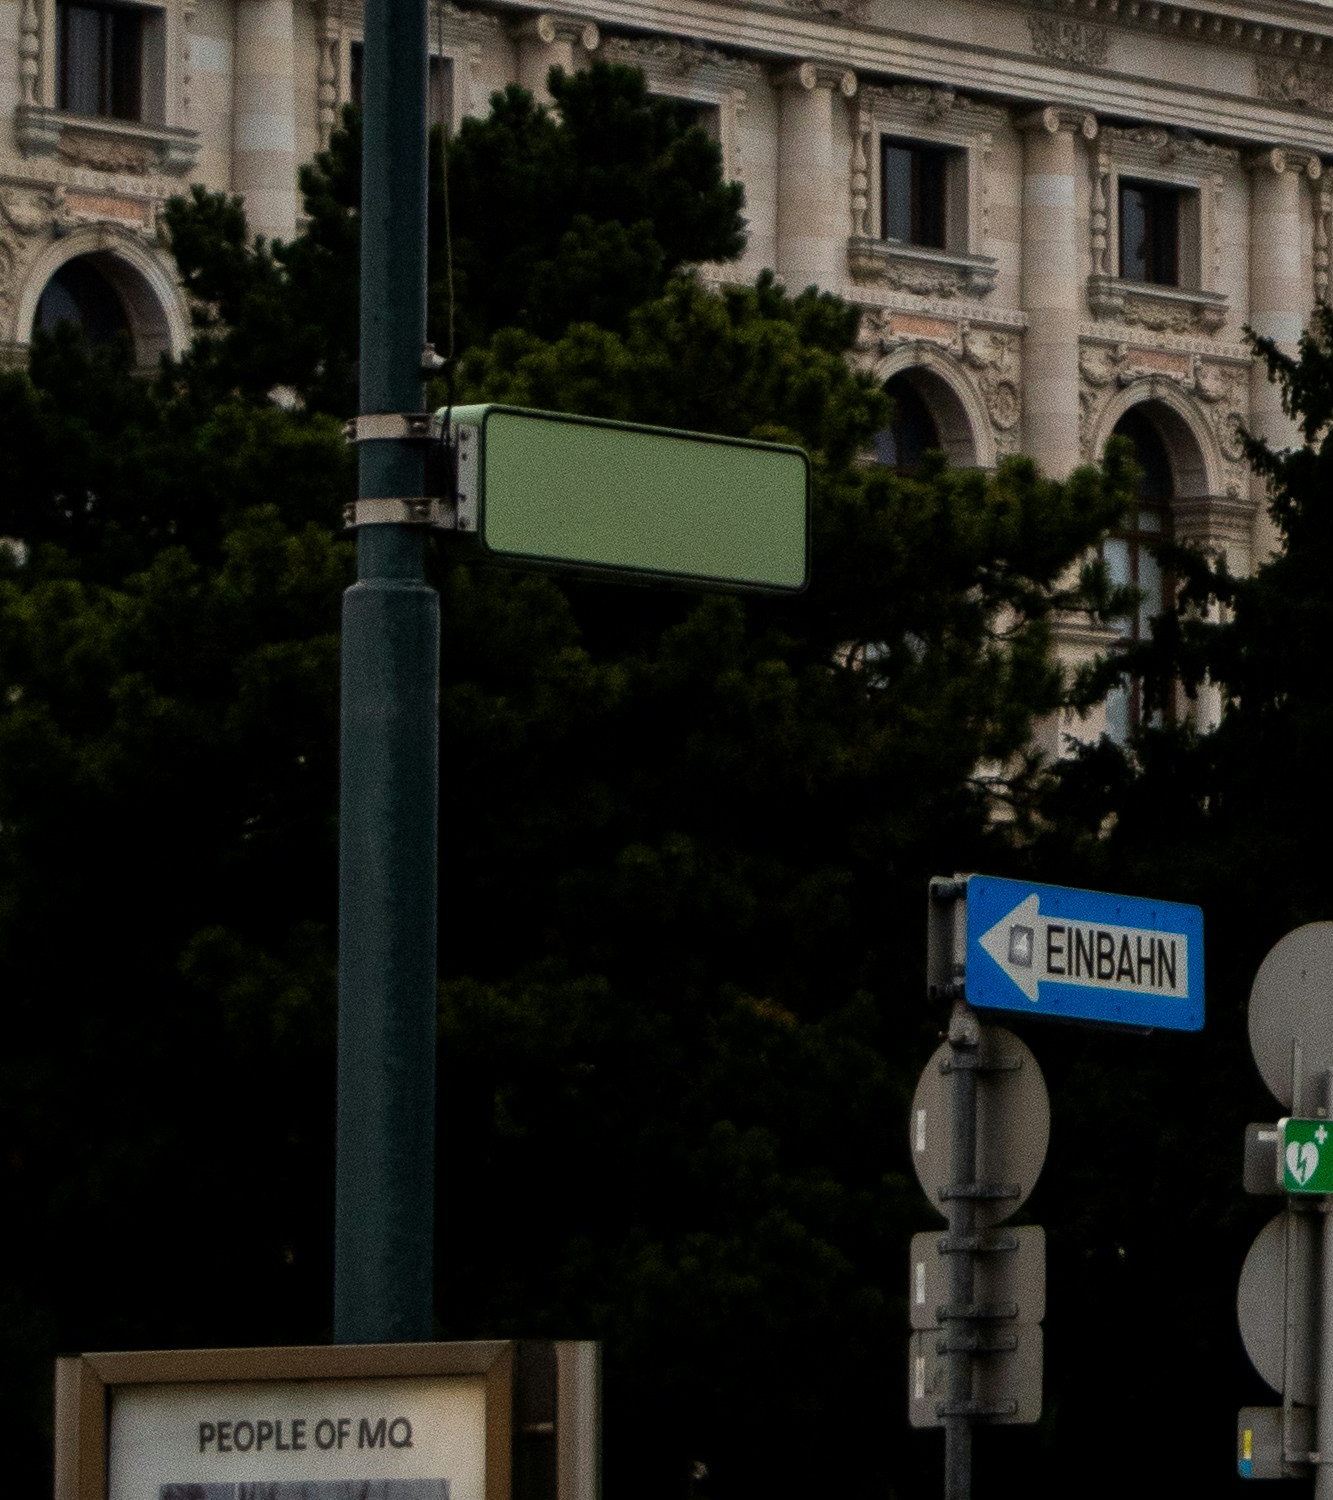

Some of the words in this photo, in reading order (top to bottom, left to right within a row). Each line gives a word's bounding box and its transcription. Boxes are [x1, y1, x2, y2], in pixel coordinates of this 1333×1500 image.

[1046, 924, 1177, 989] EINBAHN
[198, 1419, 307, 1452] PEOPLE
[315, 1418, 351, 1449] OF
[357, 1416, 414, 1449] MQ
